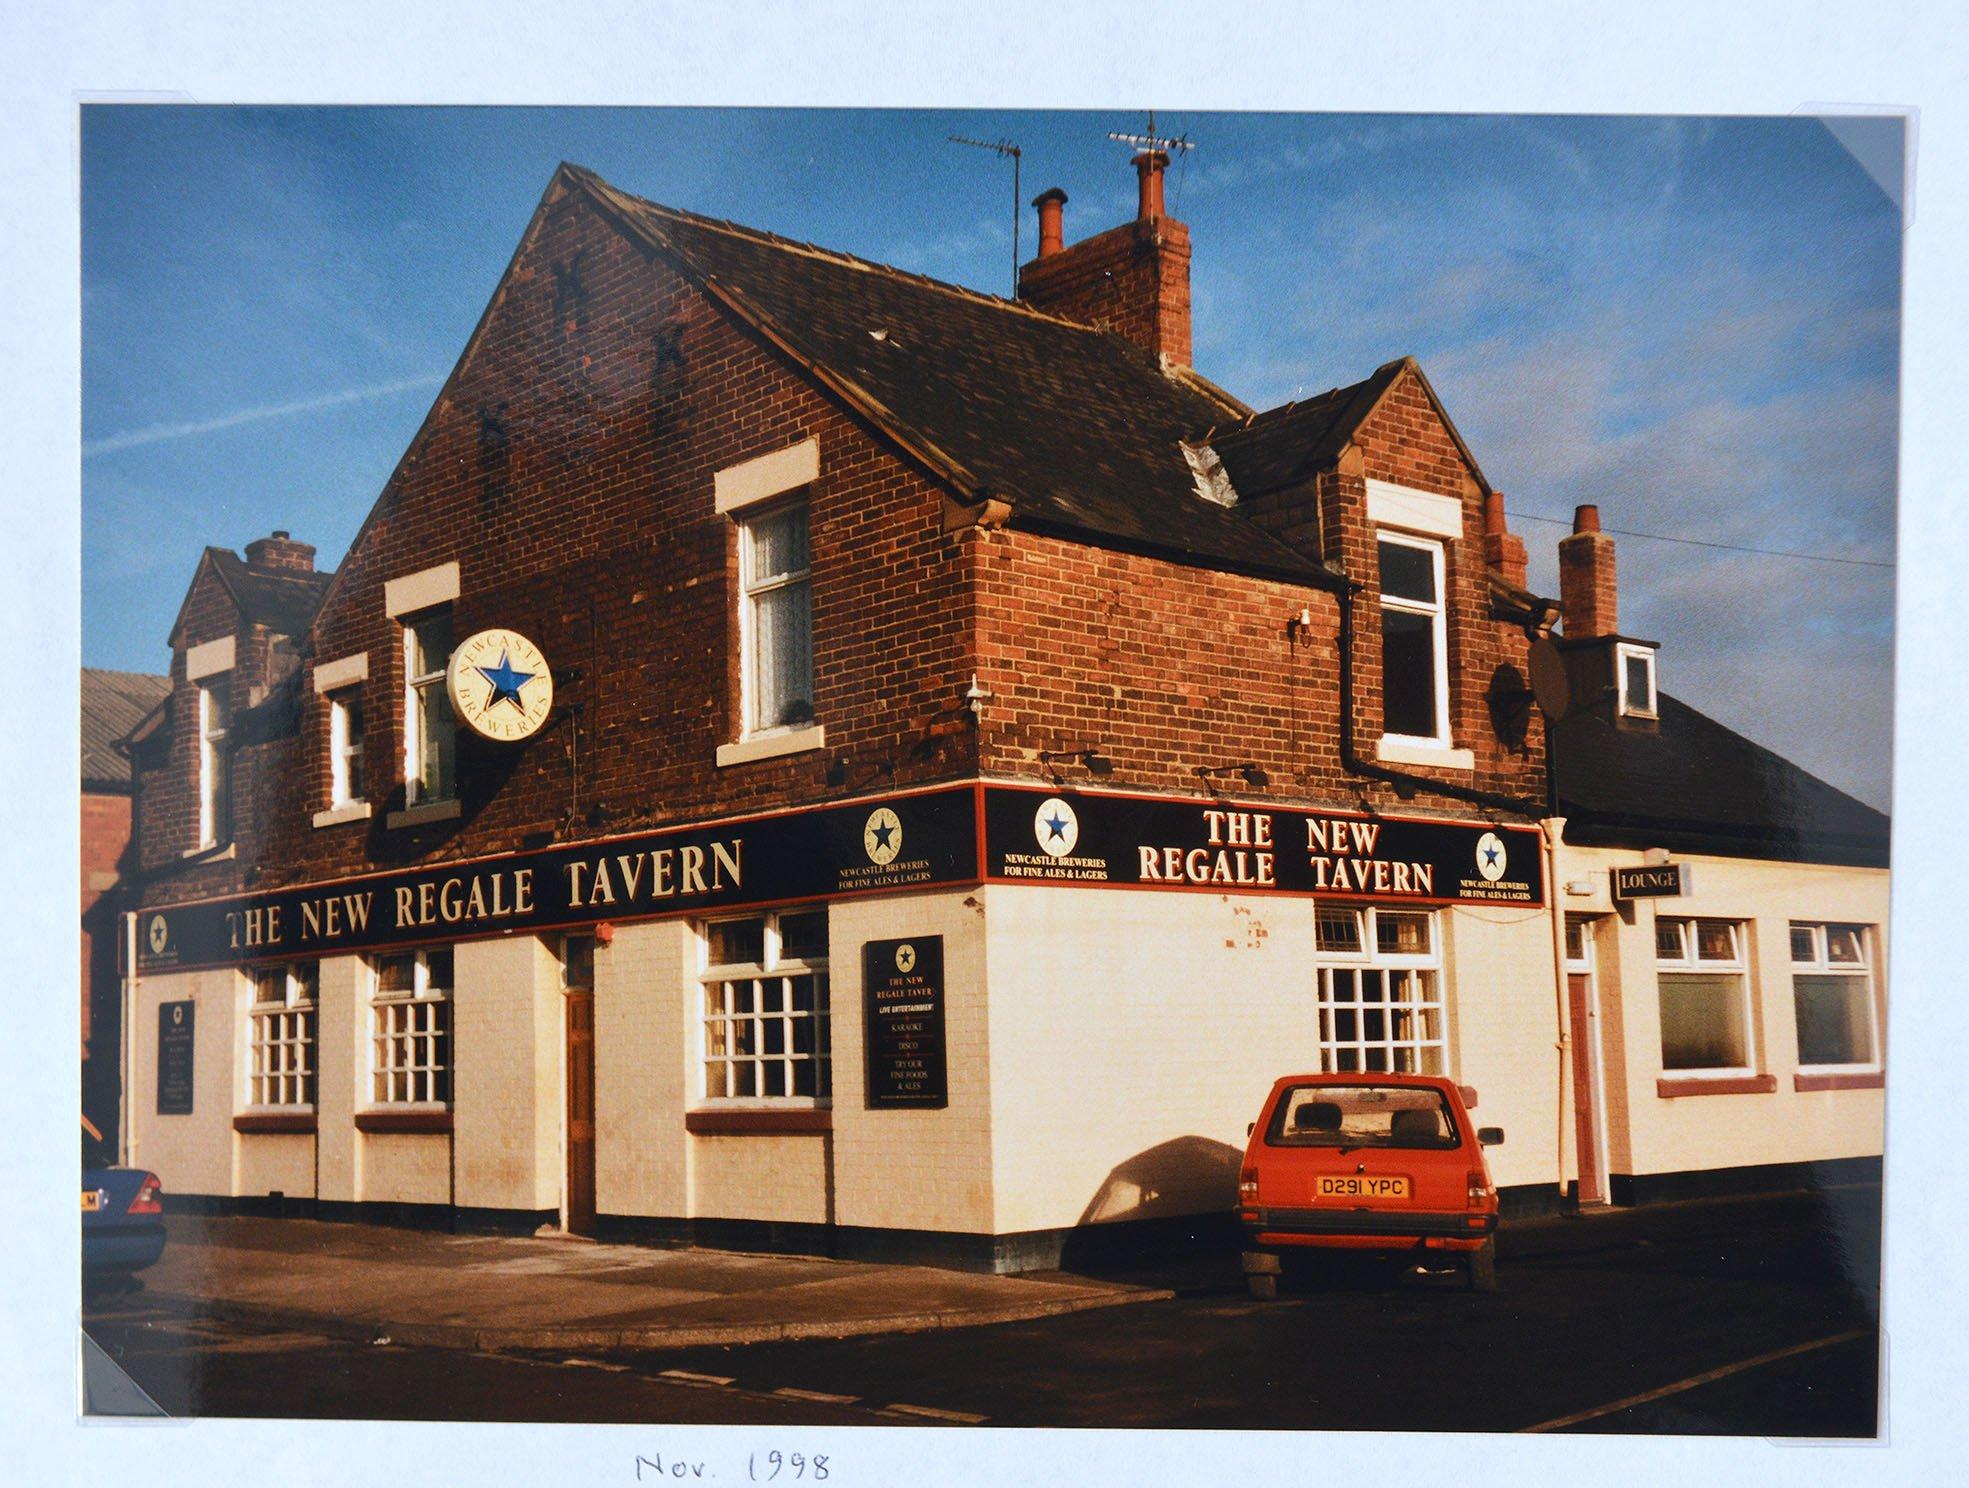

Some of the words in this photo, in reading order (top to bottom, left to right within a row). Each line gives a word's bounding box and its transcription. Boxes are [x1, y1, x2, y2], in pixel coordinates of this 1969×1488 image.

[1203, 810, 1274, 847] THE
[1305, 817, 1380, 855] NEW
[840, 864, 883, 878] NEWCASTLE
[885, 859, 930, 873] BREWERIES
[1005, 853, 1057, 866] NEWCASTLE
[1058, 857, 1106, 869] BREWERIES
[1004, 866, 1022, 876] FOR
[1023, 867, 1043, 877] FINE
[1044, 868, 1066, 878] ALES
[1066, 869, 1073, 878] &
[1075, 869, 1108, 880] LAGERS
[1138, 846, 1276, 887] REGALE
[1311, 856, 1433, 895] TAVERN
[839, 880, 853, 890] FOR
[855, 878, 871, 889] FINE
[874, 876, 892, 886] ALES
[900, 871, 932, 883] LAGERS
[1460, 879, 1495, 889] NEWCASTLE
[1496, 880, 1530, 890] BREWERIES
[1621, 872, 1677, 889] LOUNGE
[225, 905, 282, 948] THE
[300, 891, 374, 940] NEW
[394, 868, 535, 928] REGALE
[563, 839, 744, 908] TAVERN
[1460, 889, 1472, 897] FOR
[1473, 890, 1486, 898] FINE
[1487, 891, 1500, 899] ALES
[1508, 892, 1532, 900] LAGERS
[889, 978, 903, 986] THE
[906, 976, 925, 984] NEW
[876, 989, 905, 999] REGALE
[879, 1005, 891, 1014] LIVE
[890, 1023, 923, 1032] KARAOKE
[898, 1042, 919, 1050] DISCO
[1322, 1179, 1363, 1195] D291
[1368, 1179, 1403, 1195] YPC
[634, 1452, 717, 1481] Nov.
[749, 1449, 830, 1481] 1998
